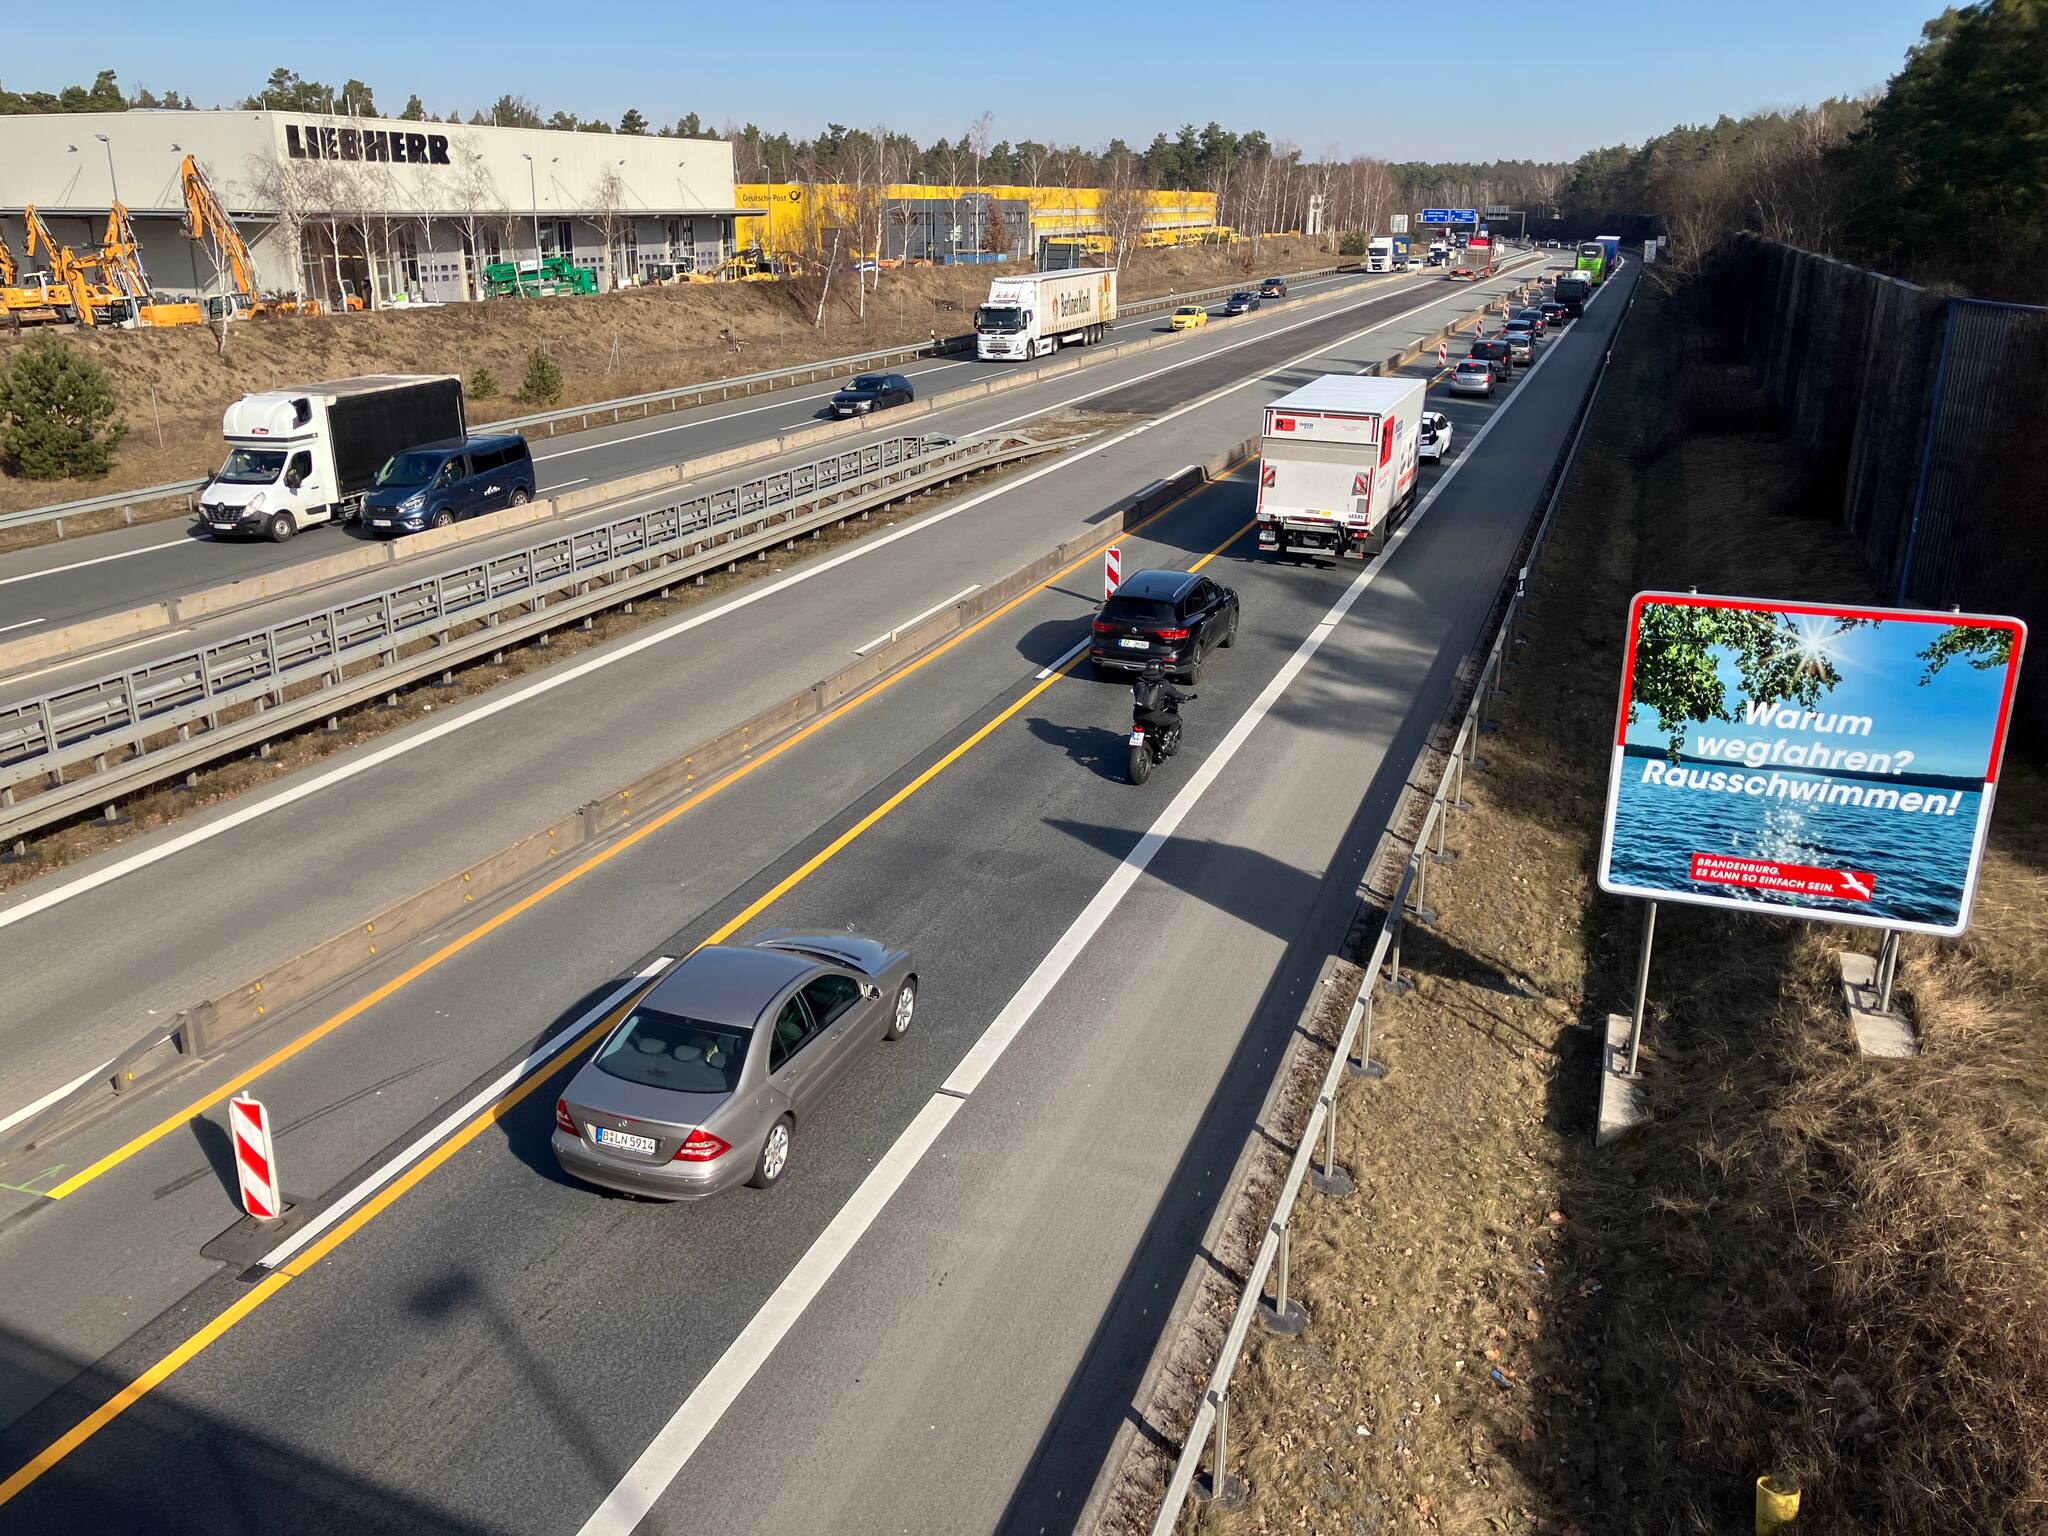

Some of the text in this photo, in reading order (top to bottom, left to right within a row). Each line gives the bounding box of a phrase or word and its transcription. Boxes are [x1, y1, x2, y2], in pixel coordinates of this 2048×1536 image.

[285, 124, 451, 165] LIEBHERR
[772, 193, 787, 202] Post
[1745, 700, 1873, 736] Warum
[1696, 735, 1915, 775] wegfahren?
[1641, 759, 1963, 816] Rausschwimmen!
[1695, 868, 1834, 893] ES KANN SO EINFACH SEIN.
[1697, 857, 1780, 875] BRANDENBURG.
[629, 1136, 653, 1151] 5914
